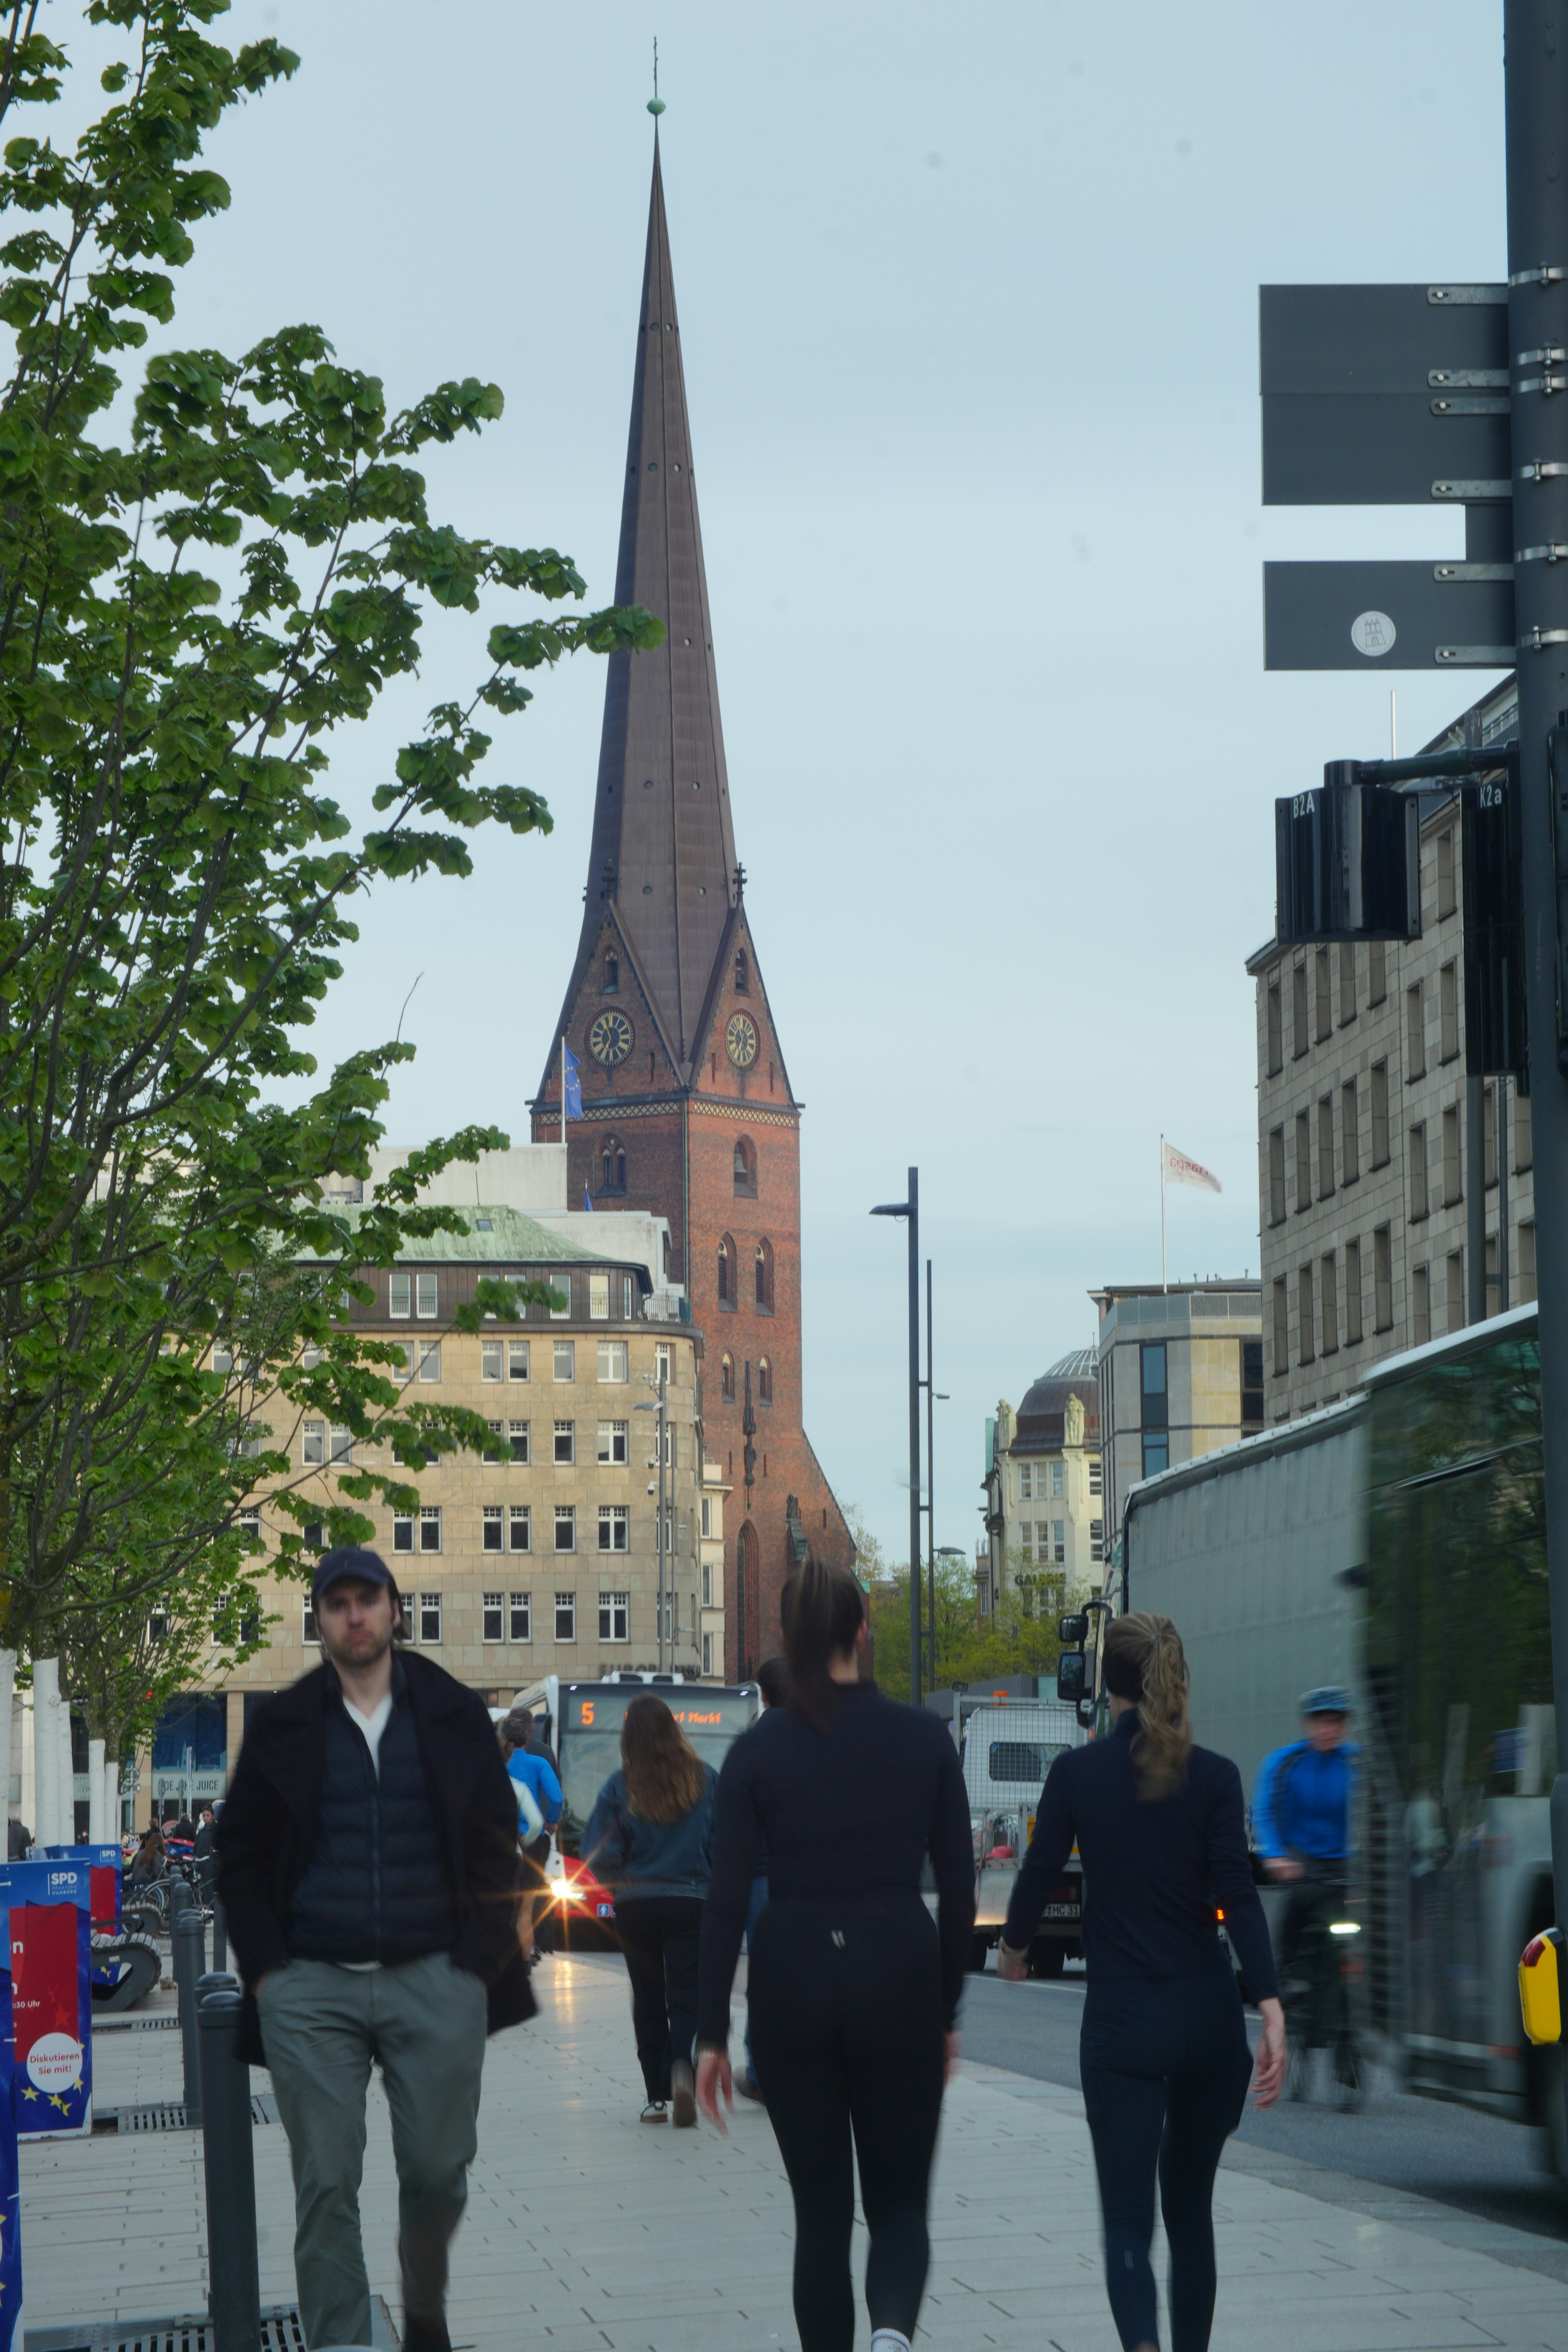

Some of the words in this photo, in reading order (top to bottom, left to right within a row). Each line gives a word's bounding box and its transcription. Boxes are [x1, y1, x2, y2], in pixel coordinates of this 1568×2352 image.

[1479, 784, 1502, 809] K2a
[1293, 791, 1315, 819] B2A
[581, 1702, 595, 1725] 5
[197, 1780, 218, 1791] JUICE
[51, 1871, 77, 1885] SPD
[27, 2000, 41, 2008] Uhr
[30, 2052, 79, 2063] Diskutieren
[38, 2065, 51, 2075] Sie
[54, 2064, 72, 2074] mit!
